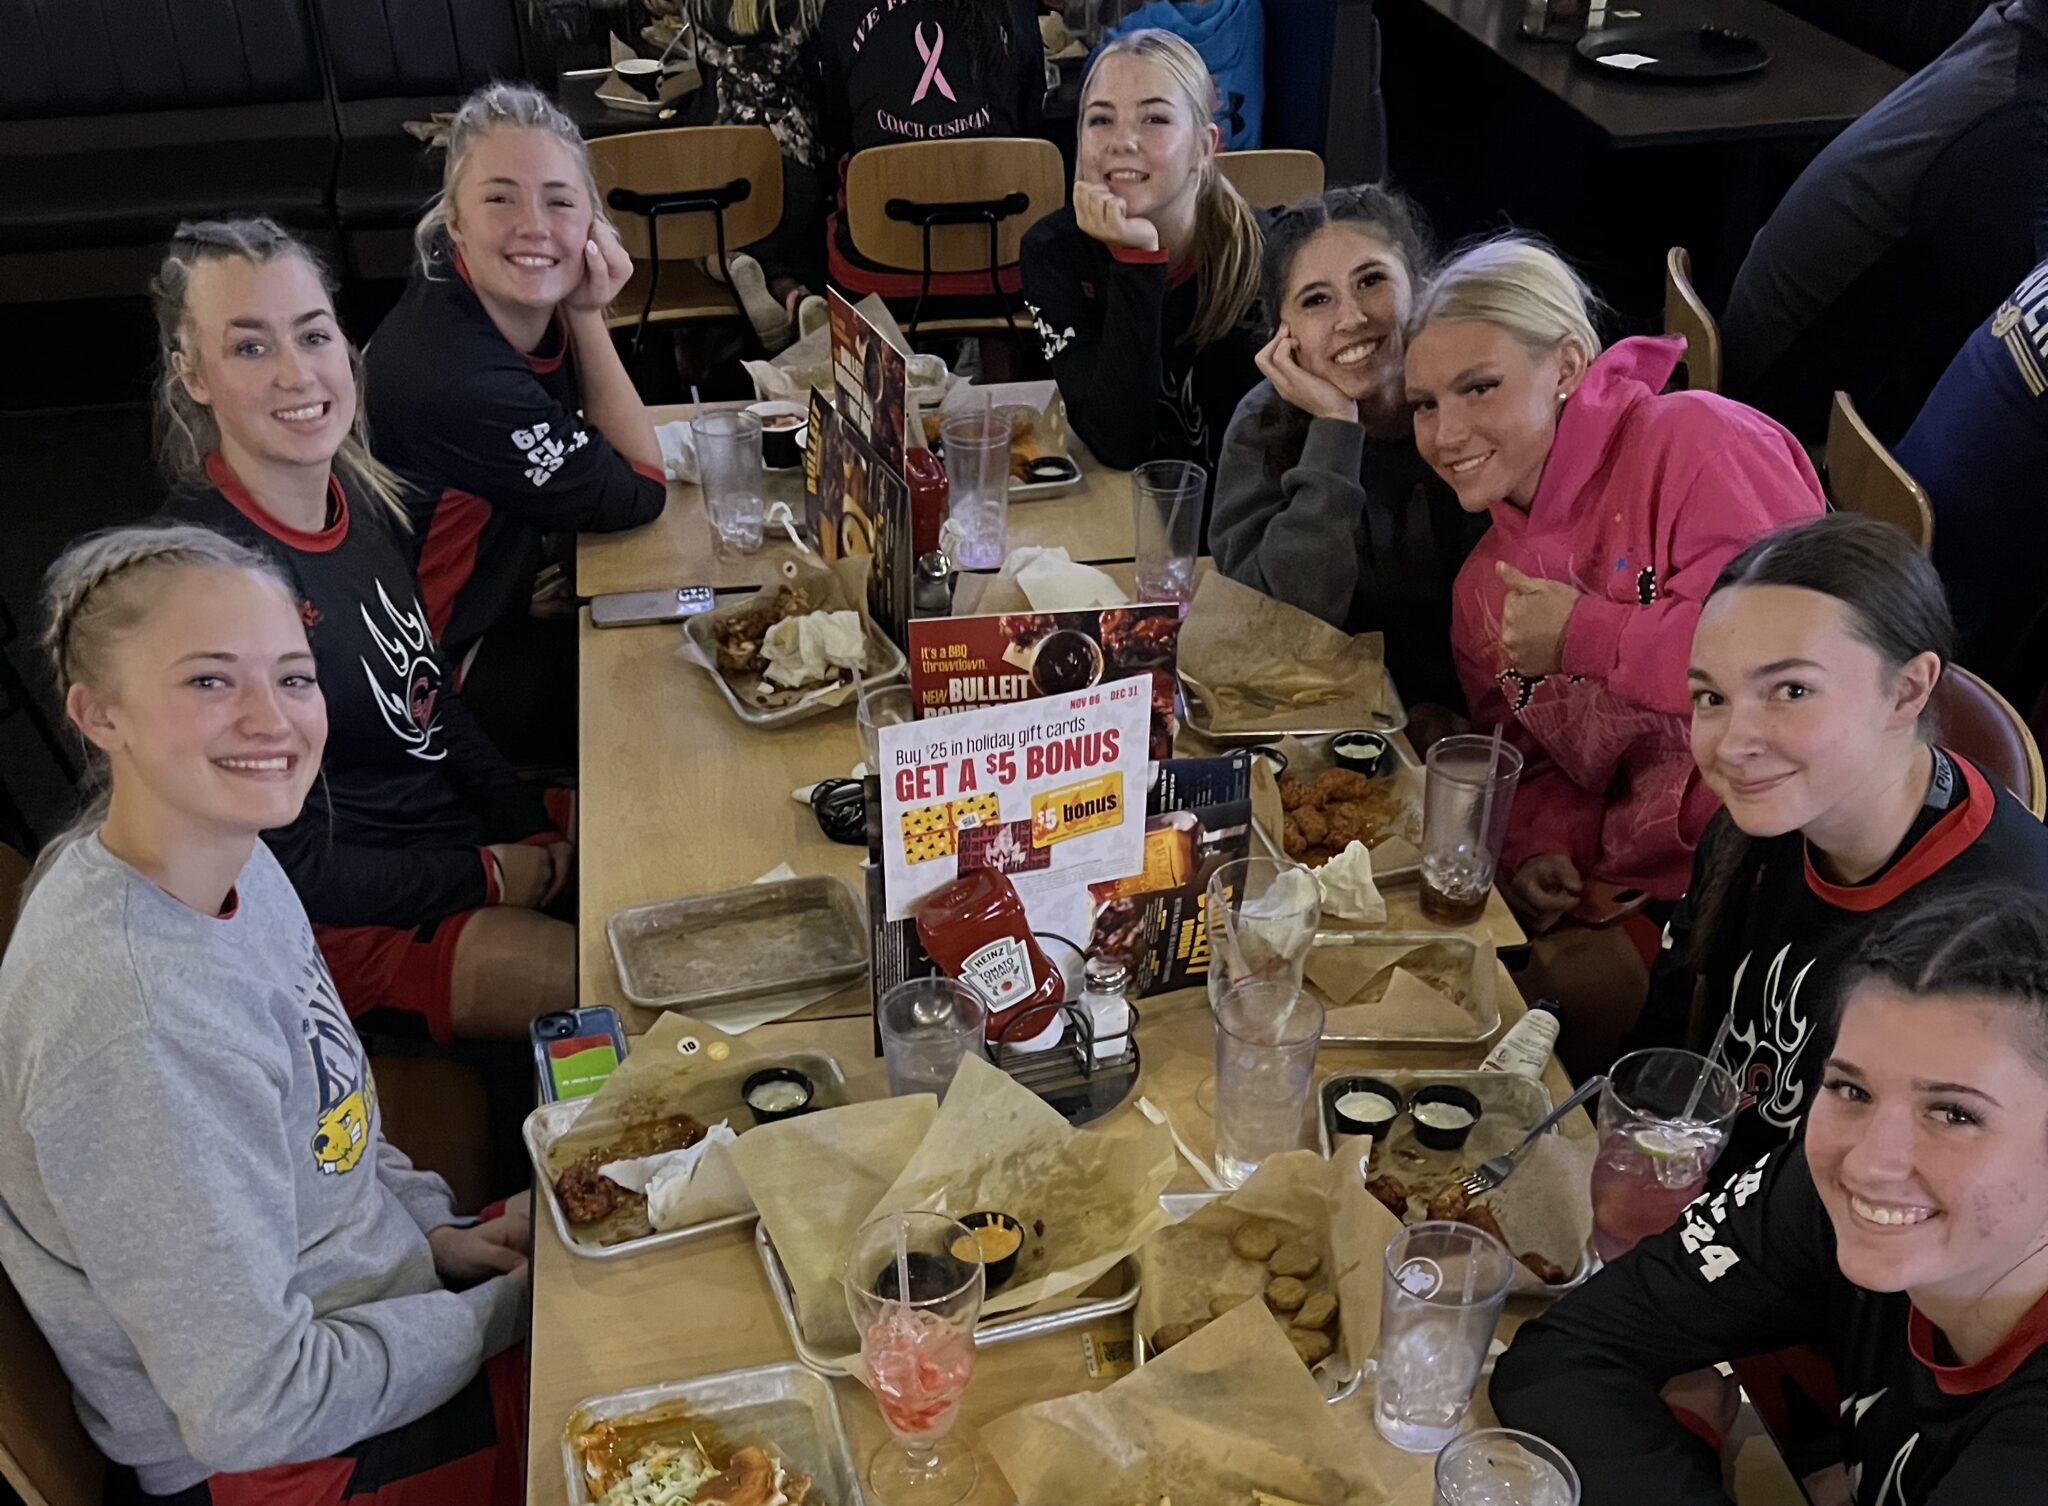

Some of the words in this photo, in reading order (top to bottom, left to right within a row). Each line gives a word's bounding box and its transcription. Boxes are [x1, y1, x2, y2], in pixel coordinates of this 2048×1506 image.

[877, 109, 924, 138] COACH
[929, 105, 990, 138] CUSHMAN
[939, 648, 947, 659] a
[948, 644, 967, 659] BBQ
[922, 689, 948, 705] NEW
[949, 674, 1031, 703] BULLEIT
[1070, 697, 1087, 710] NOV
[1110, 689, 1126, 701] DEC
[1128, 685, 1138, 698] 31
[896, 749, 921, 766] Buy
[951, 741, 963, 756] in
[967, 732, 1015, 753] holiday
[1019, 724, 1042, 747] gift
[1046, 717, 1086, 739] cards
[895, 762, 949, 802] GET
[958, 758, 978, 793] A
[986, 750, 1017, 786] $5
[1026, 728, 1120, 780] BONUS
[1037, 808, 1058, 830] $5
[1063, 794, 1117, 823] bonus
[974, 947, 1004, 968] HEINZ
[979, 957, 1014, 981] TOMATO
[682, 1041, 696, 1053] 10
[1680, 1214, 1740, 1283] 24
